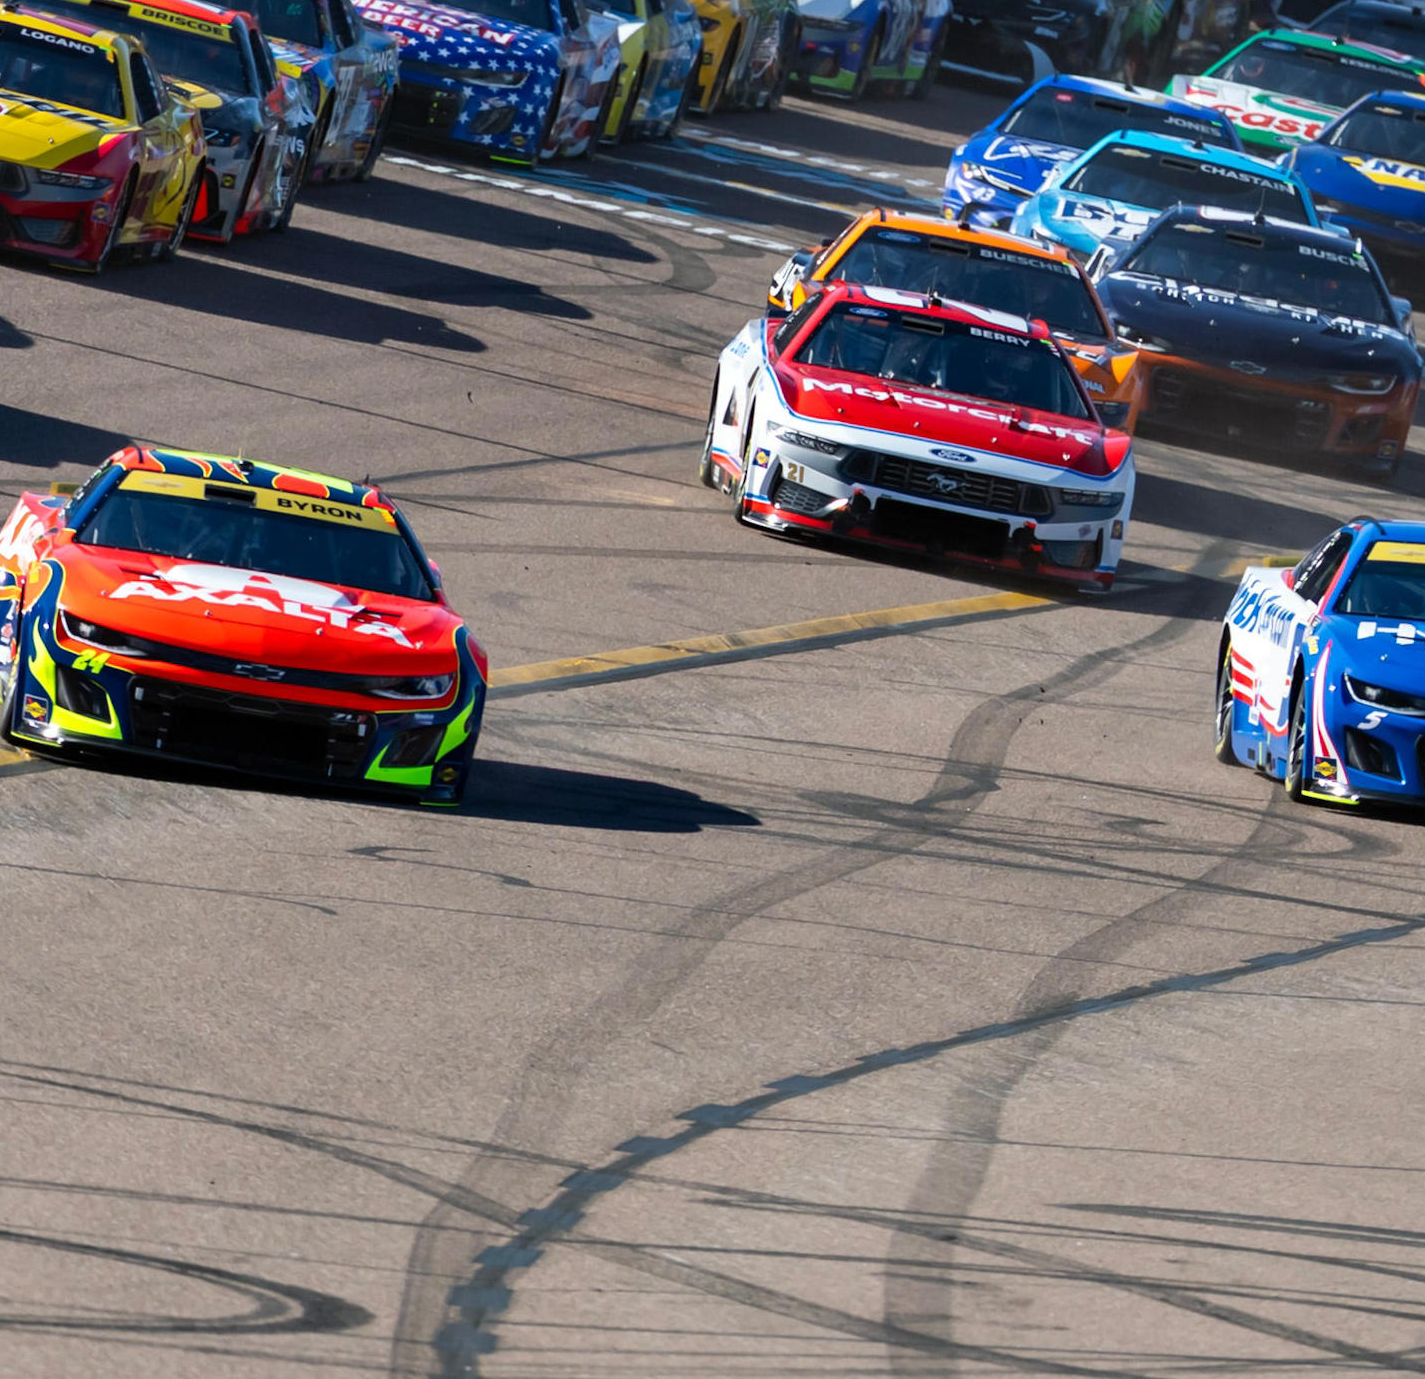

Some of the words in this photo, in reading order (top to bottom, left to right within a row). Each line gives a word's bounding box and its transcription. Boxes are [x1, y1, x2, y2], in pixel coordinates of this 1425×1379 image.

[140, 7, 224, 36] BRISCOE
[20, 27, 95, 54] LOGANO
[1164, 115, 1221, 137] JONES
[1200, 164, 1294, 195] CHASTAIN
[970, 327, 1031, 348] BERRY
[802, 377, 1093, 446] Motorcraft
[787, 462, 805, 482] 21
[277, 497, 363, 521] BYRON
[109, 579, 424, 648] AXALTA
[72, 648, 109, 674] 24
[1357, 711, 1388, 730] 5
